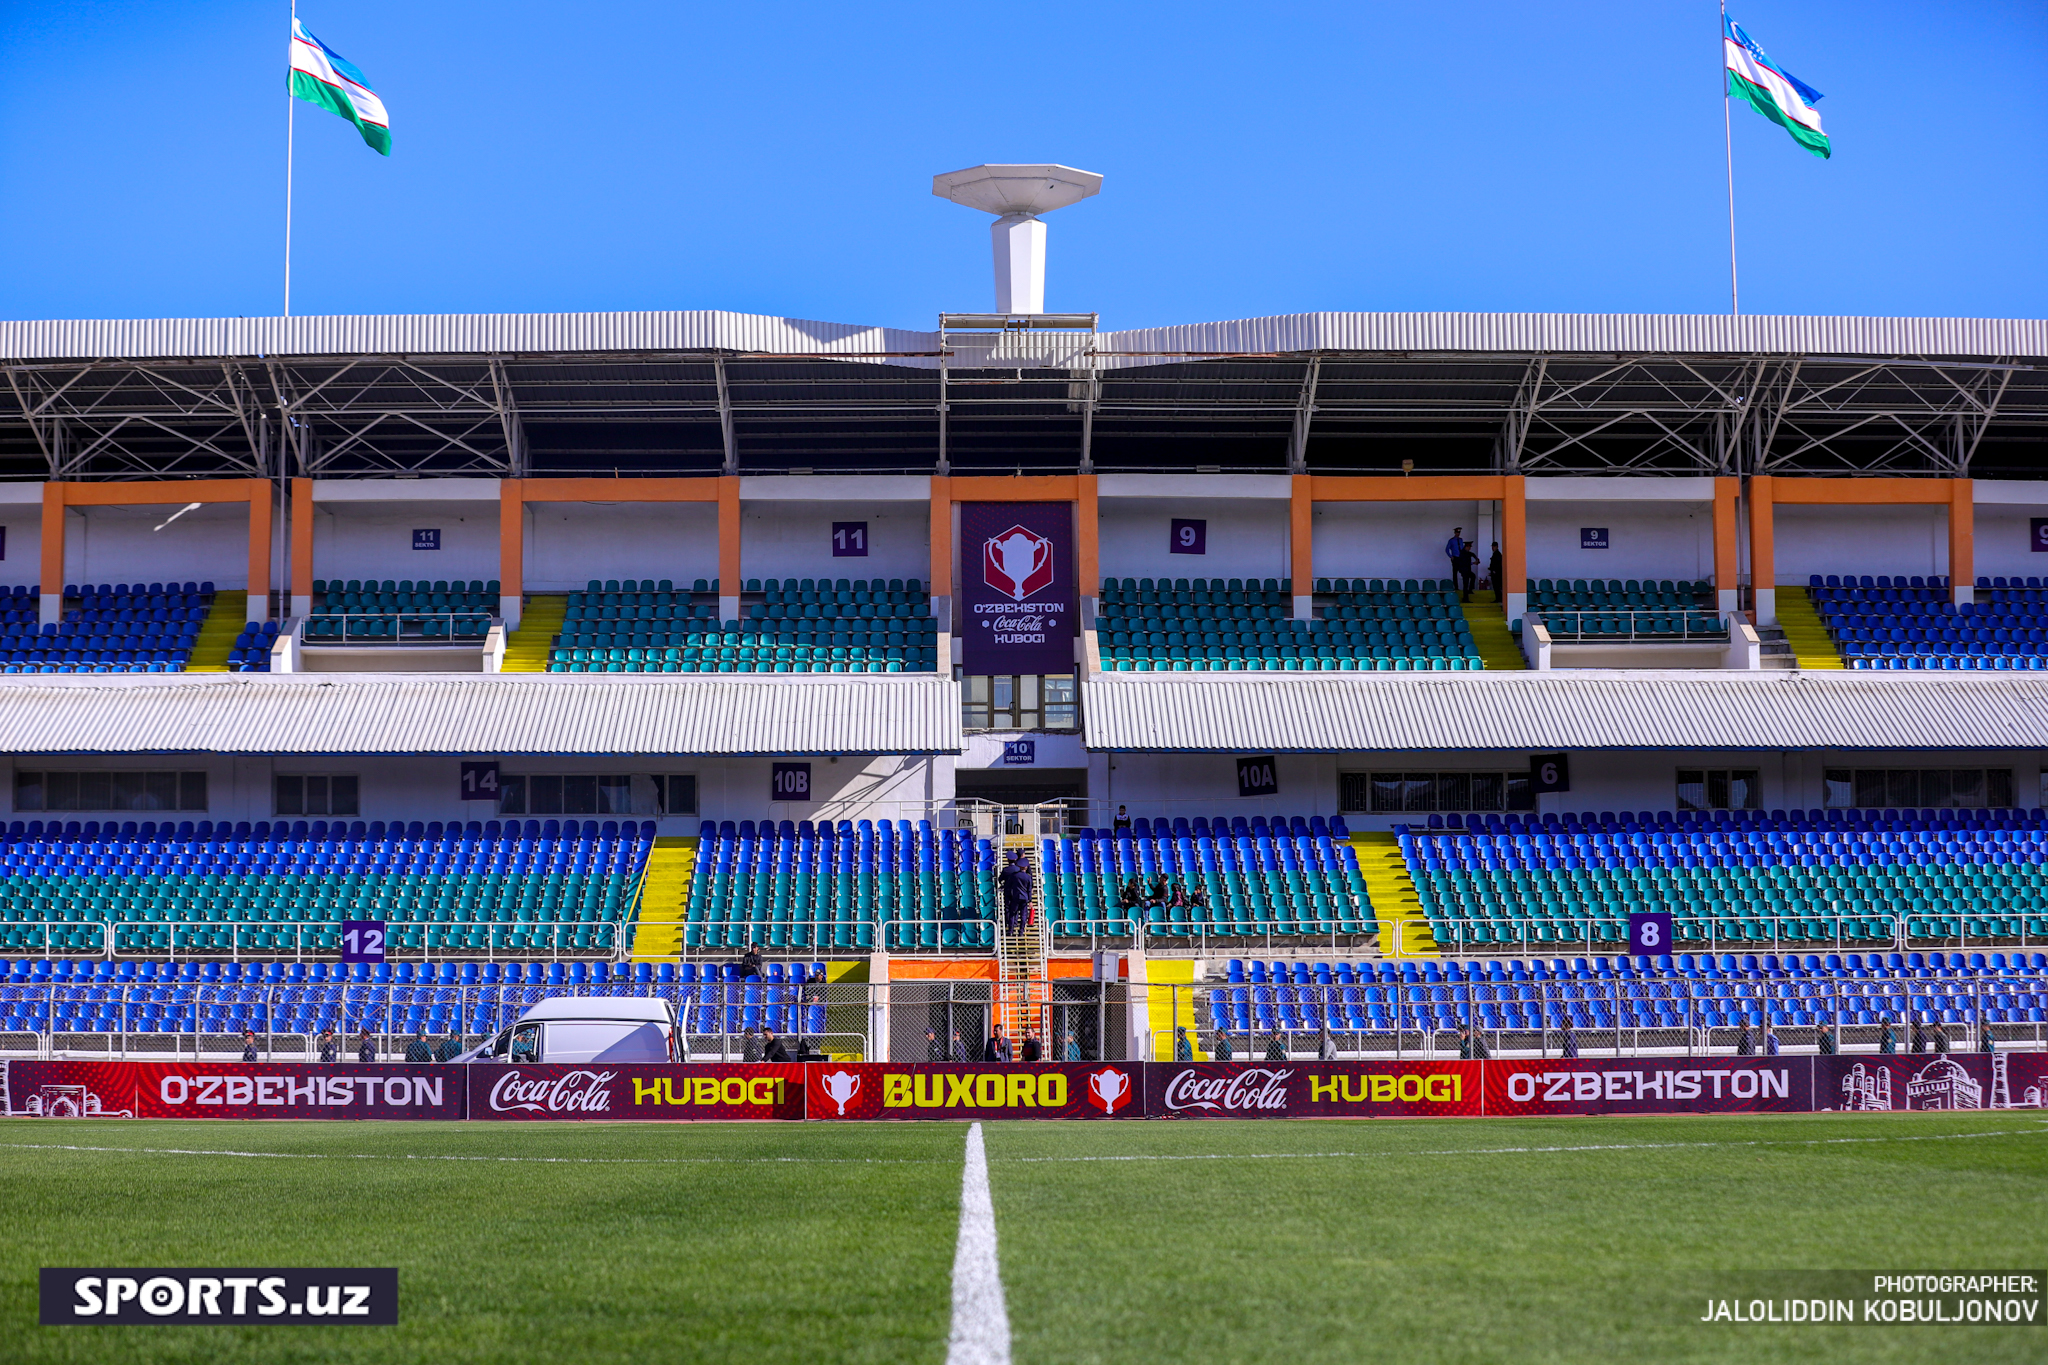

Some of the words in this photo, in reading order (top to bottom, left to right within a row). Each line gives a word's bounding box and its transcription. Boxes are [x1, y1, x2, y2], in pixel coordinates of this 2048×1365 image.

[420, 531, 434, 541] 11
[834, 529, 863, 549] 11
[1180, 526, 1196, 547] 9
[1590, 530, 1599, 540] 9
[992, 615, 1046, 632] Coca-Cola
[994, 634, 1046, 644] KUBOGI
[1011, 743, 1028, 754] 10
[463, 770, 498, 792] 14
[775, 771, 808, 793] 10B
[1240, 765, 1275, 788] 10A
[1541, 763, 1558, 785] 6
[344, 929, 383, 954] 12
[1640, 921, 1660, 947] 8
[489, 1070, 619, 1112] Coca-Cola
[631, 1077, 785, 1105] KUBOGI
[883, 1073, 1068, 1108] BUXORO
[1164, 1068, 1295, 1110] Coca-Cola
[1308, 1074, 1462, 1102] KUBOGI
